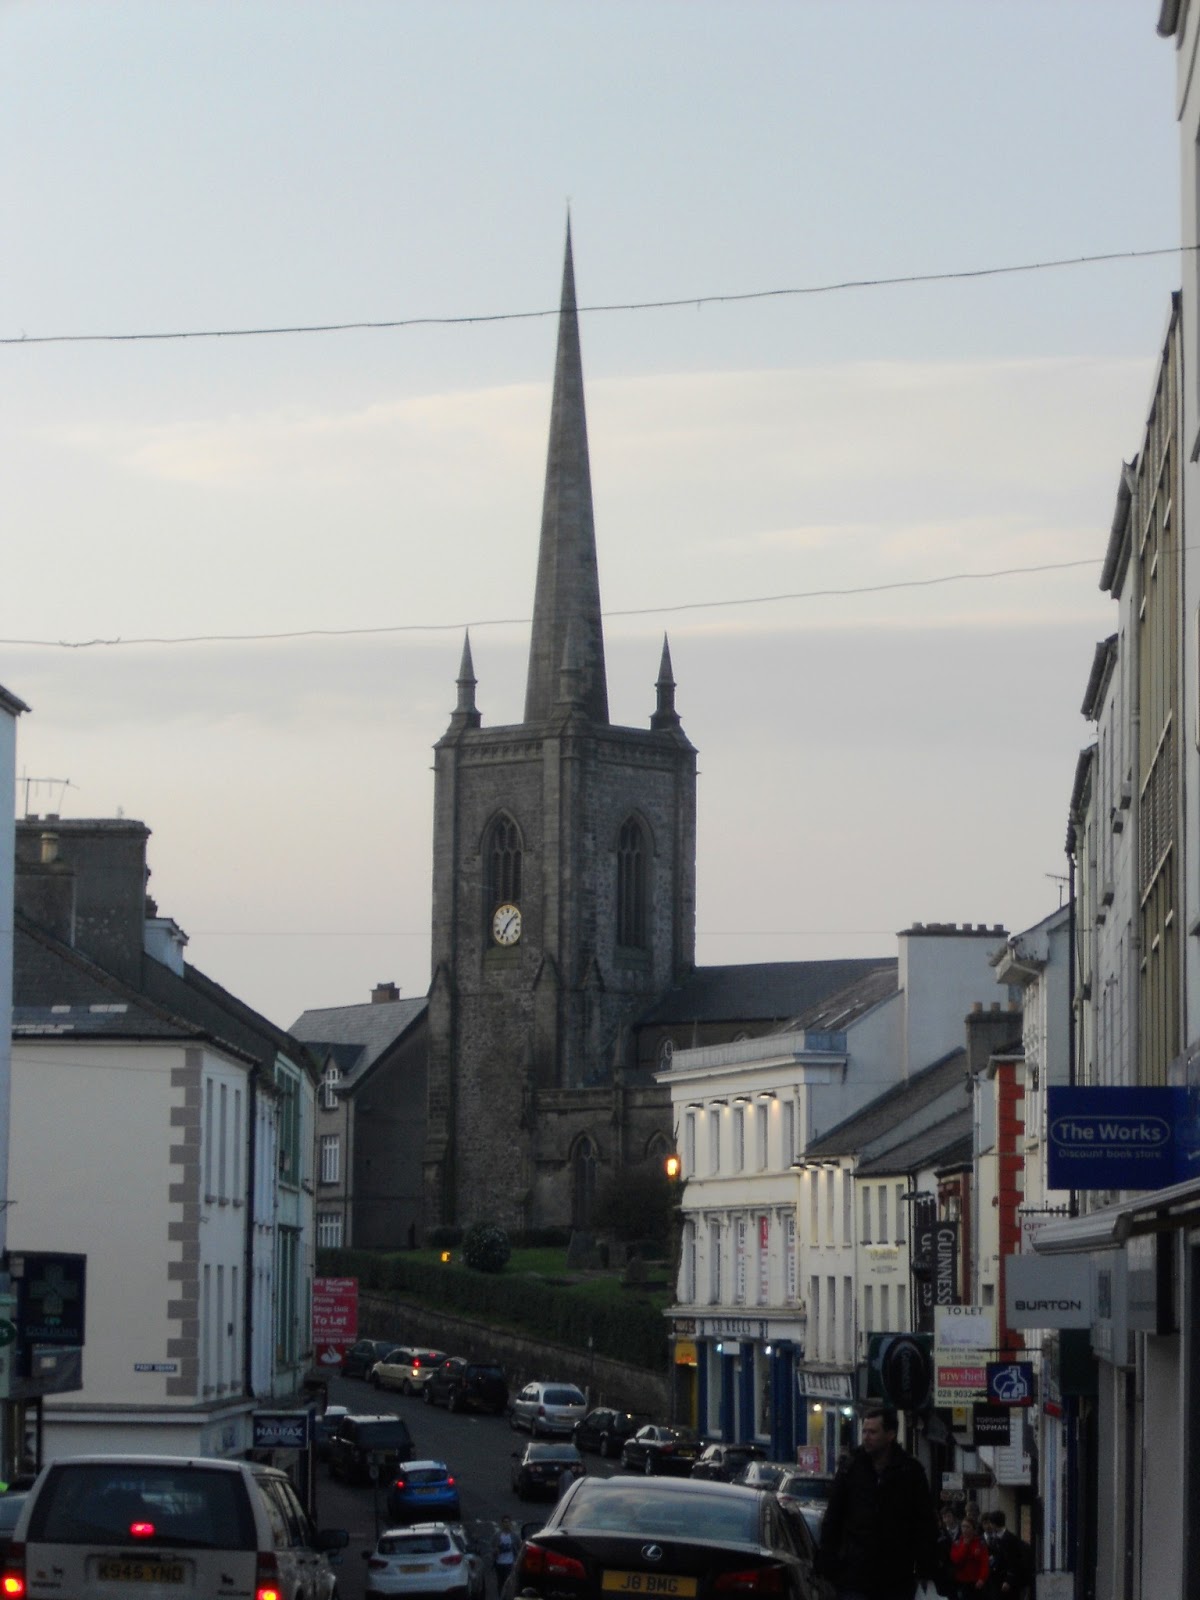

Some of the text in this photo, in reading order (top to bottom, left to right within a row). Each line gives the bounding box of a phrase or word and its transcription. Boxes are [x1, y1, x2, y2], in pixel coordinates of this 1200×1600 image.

[1059, 1122, 1162, 1142] The Works
[1058, 1149, 1162, 1159] Discount book store
[937, 1228, 955, 1306] GUINNESS
[1015, 1299, 1082, 1311] BURTON
[946, 1307, 984, 1316] TO LET
[313, 1315, 347, 1325] To Let
[940, 1368, 987, 1382] BTW shiell
[937, 1389, 952, 1398] 028
[976, 1416, 1008, 1424] TOPSHOP
[256, 1427, 304, 1437] HALIFAX
[976, 1424, 1008, 1432] TOPMAN
[646, 1578, 679, 1593] BMG
